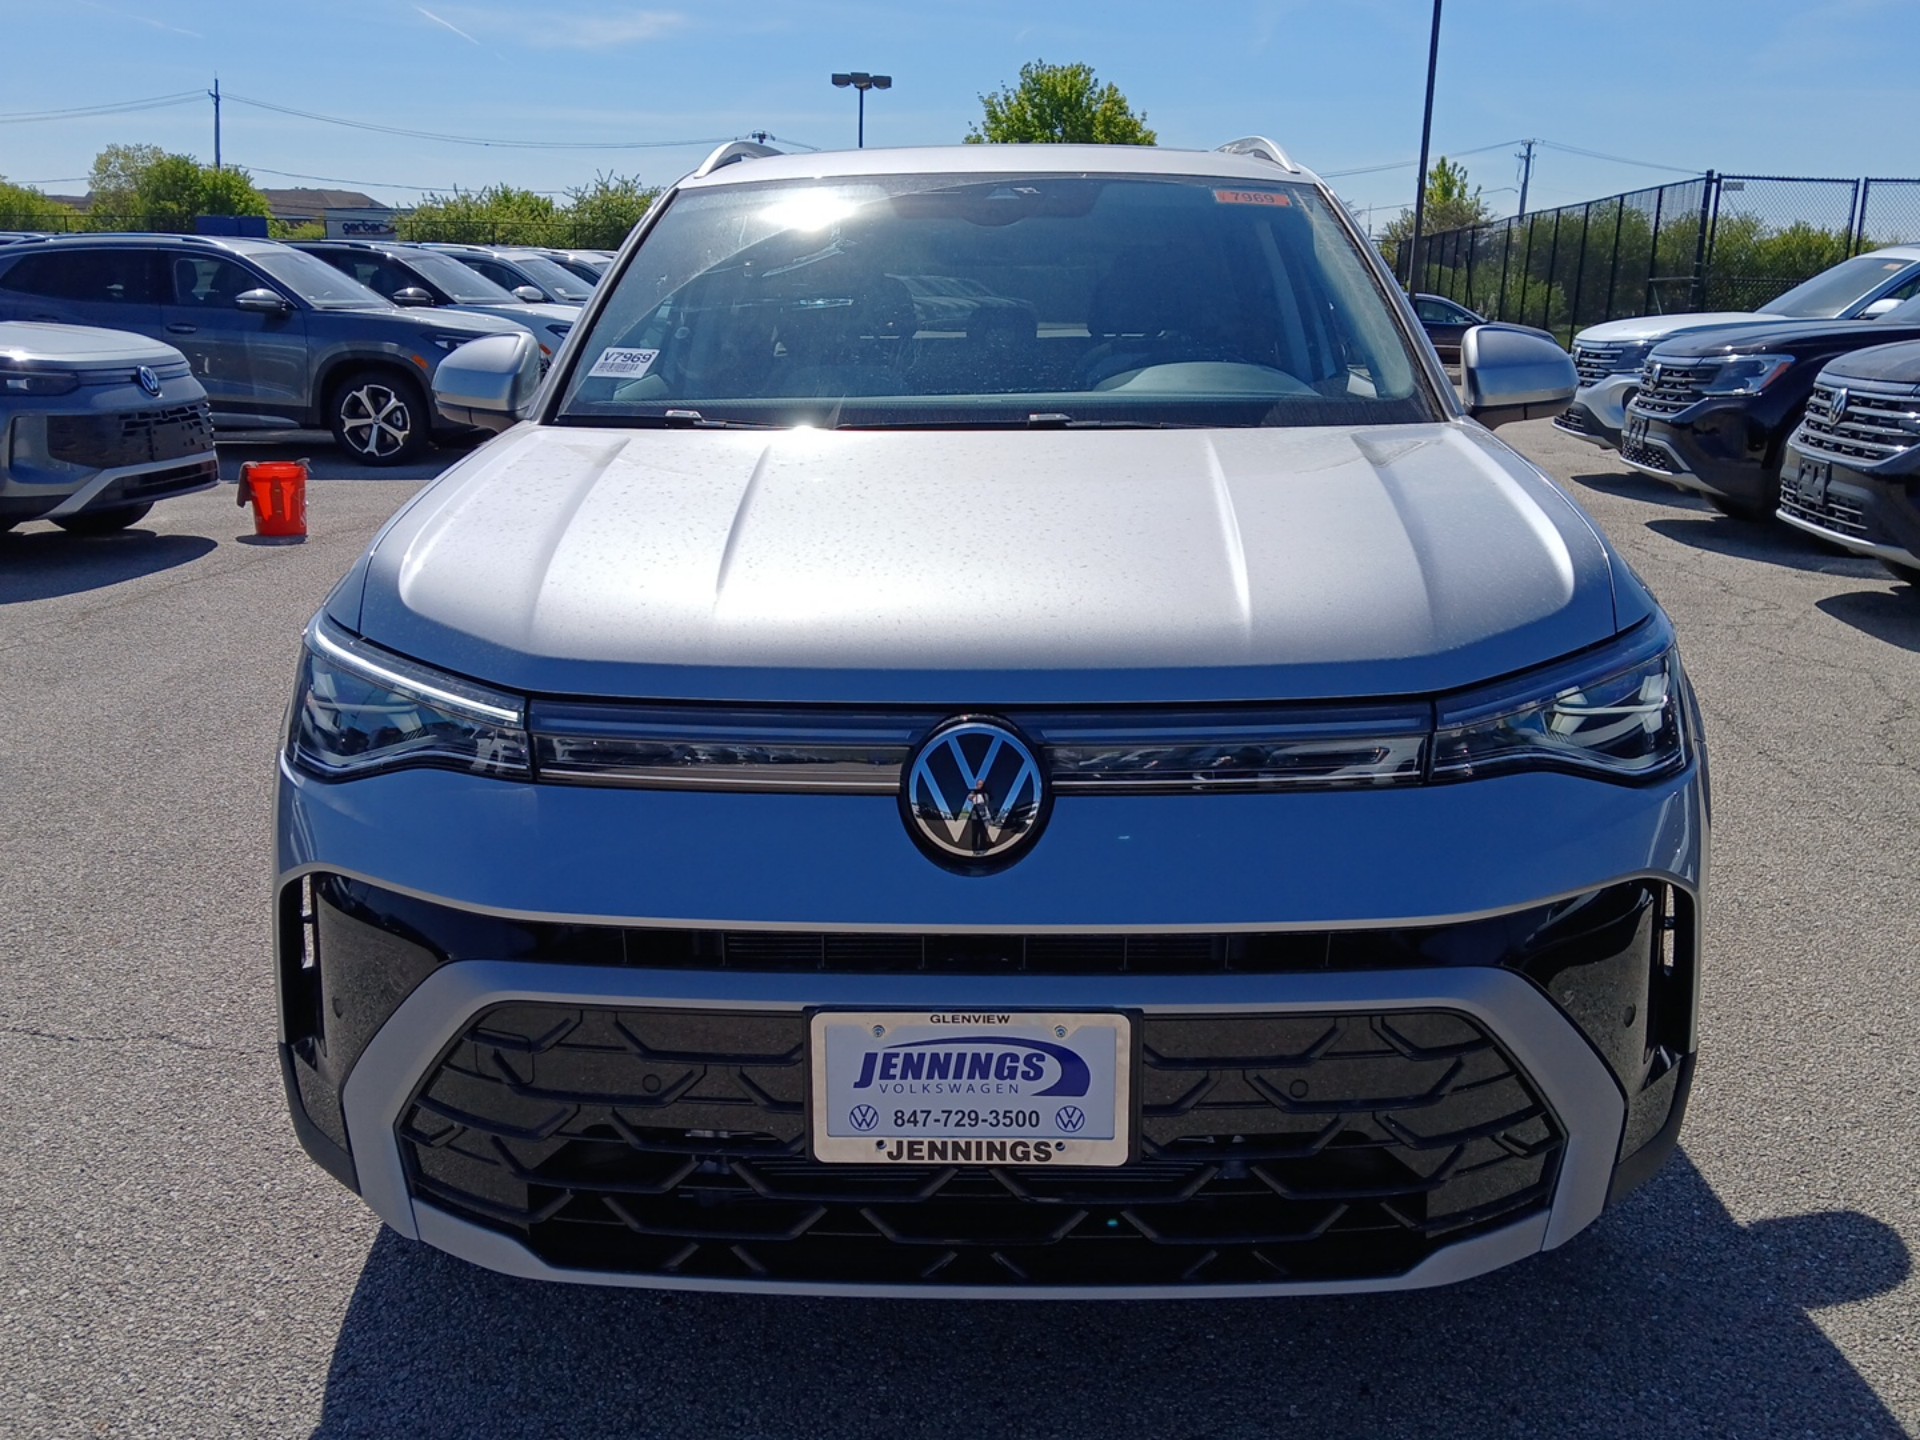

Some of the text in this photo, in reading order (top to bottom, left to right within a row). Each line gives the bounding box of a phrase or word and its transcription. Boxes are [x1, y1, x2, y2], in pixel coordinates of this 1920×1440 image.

[603, 351, 653, 364] V7969
[929, 1014, 1011, 1024] GLENVIEW
[853, 1052, 1046, 1089] JENNINGS
[878, 1083, 1019, 1094] VOLKSWAGEN
[893, 1109, 1041, 1128] 847-729-3500
[887, 1140, 1053, 1162] JENNINGS
